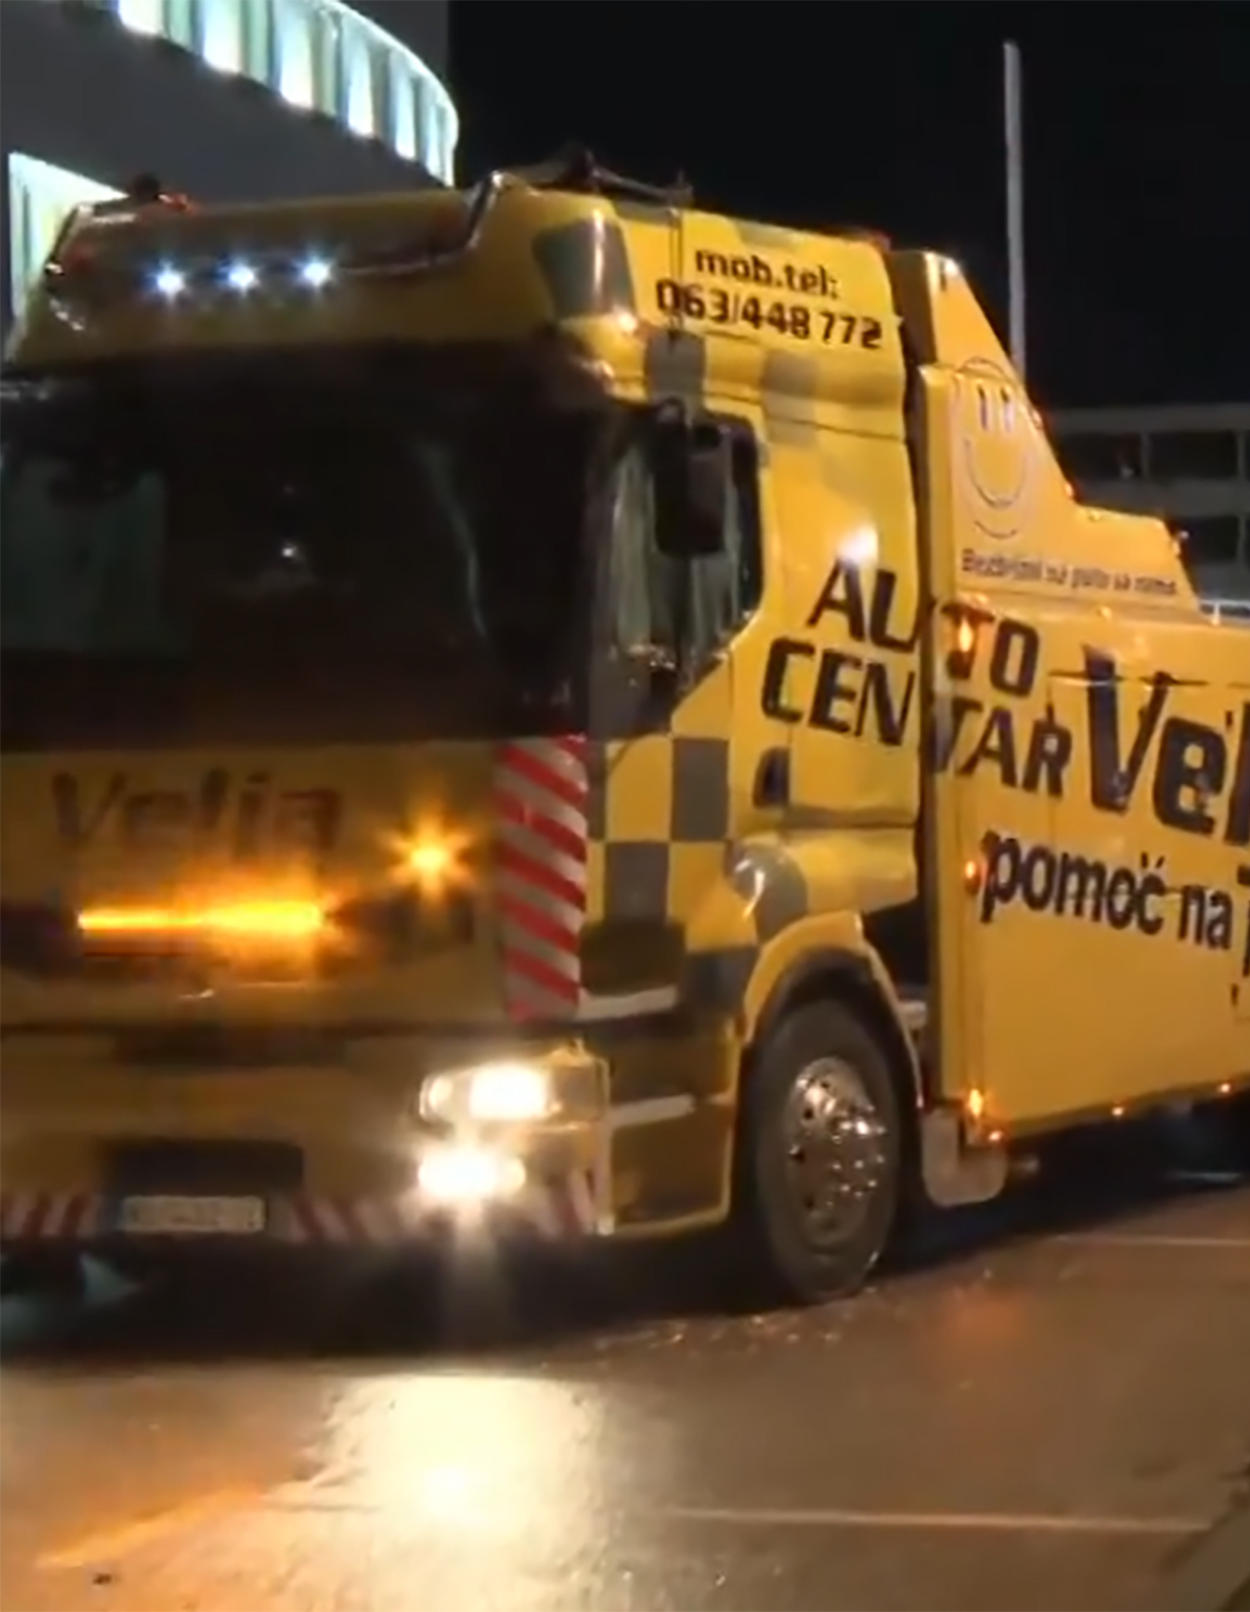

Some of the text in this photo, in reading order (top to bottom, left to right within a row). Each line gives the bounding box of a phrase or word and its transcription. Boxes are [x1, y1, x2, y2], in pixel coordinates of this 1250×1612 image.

[695, 249, 840, 300] mob.tel:
[820, 310, 883, 350] 772
[806, 558, 1040, 698] AUTO
[761, 636, 1073, 798] CENTAR
[1177, 884, 1233, 950] na
